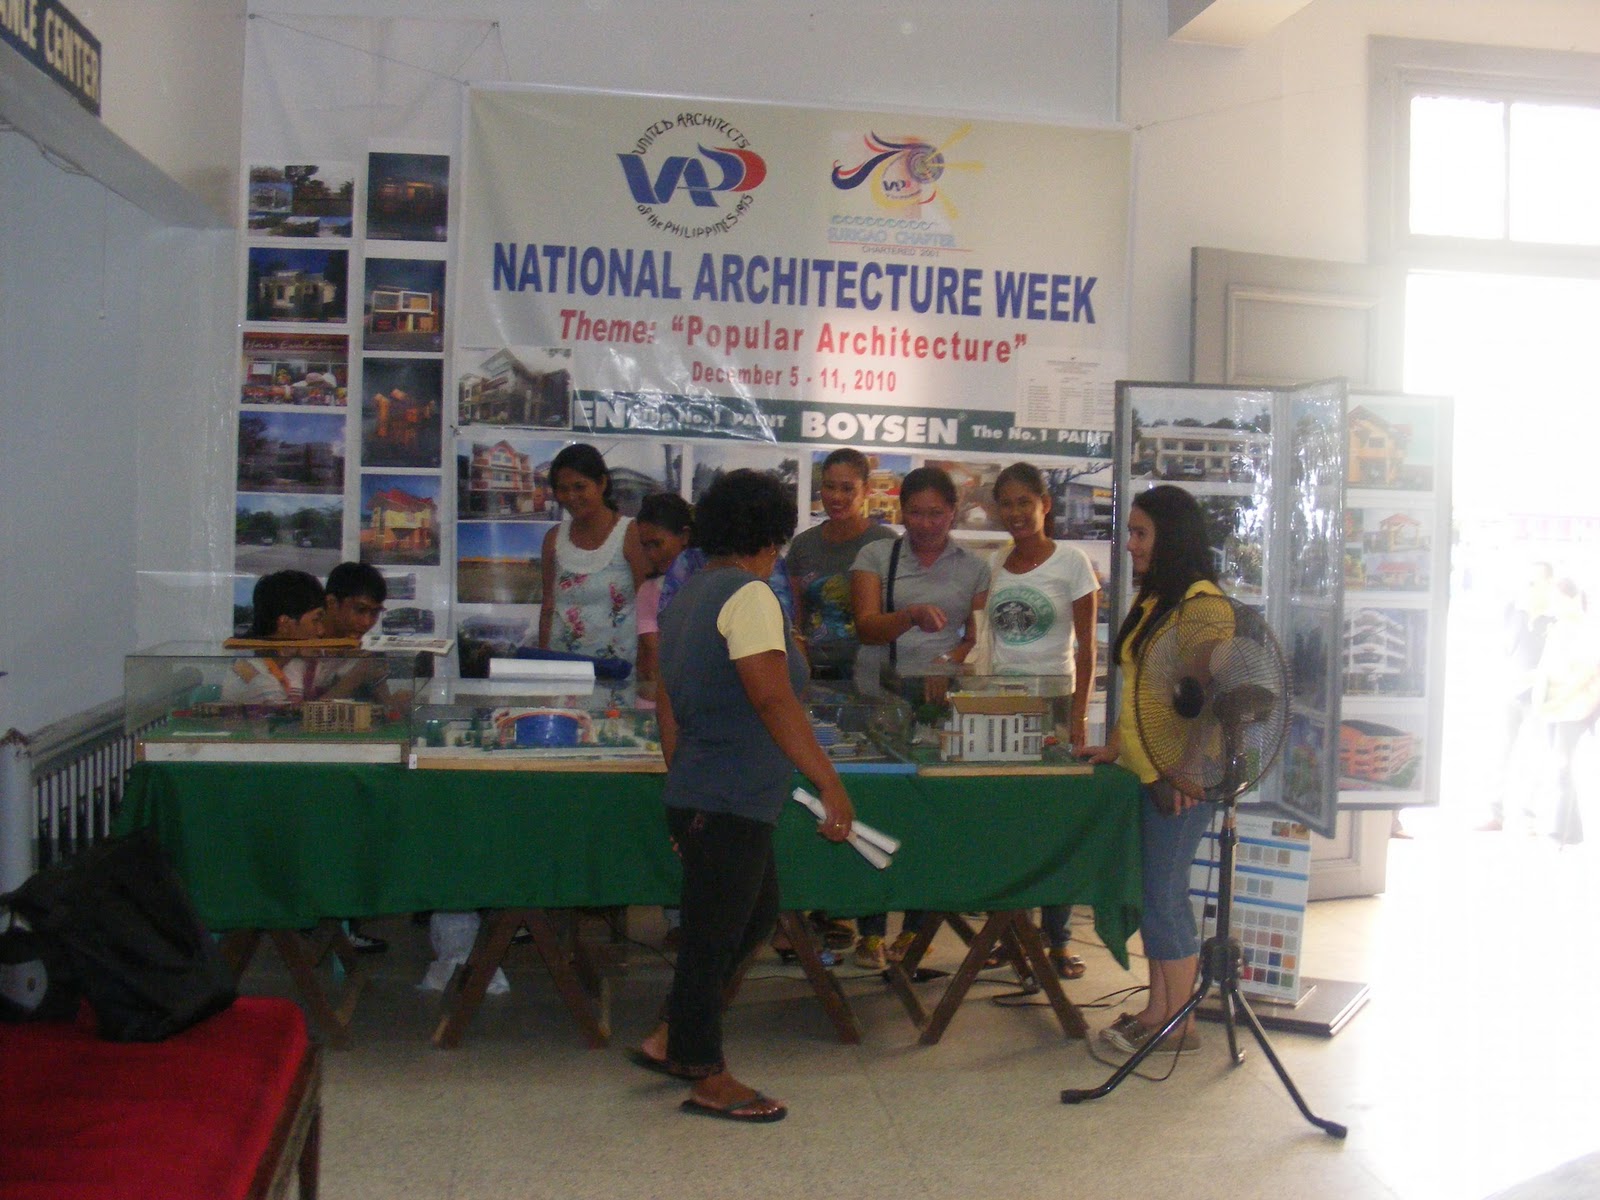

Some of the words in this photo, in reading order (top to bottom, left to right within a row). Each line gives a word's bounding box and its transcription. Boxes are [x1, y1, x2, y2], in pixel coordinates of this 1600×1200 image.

[44, 8, 98, 99] CENTER
[631, 120, 674, 154] UNITED
[677, 113, 750, 149] ARCHITECTS
[637, 204, 652, 215] of
[648, 214, 663, 229] the
[861, 245, 916, 256] CHARTERED
[493, 242, 682, 299] NATIONAL
[692, 252, 983, 316] ARCHITECTURE
[995, 270, 1097, 324] WEEK
[560, 309, 657, 344] Theme:
[672, 314, 804, 356] “Popular
[816, 322, 1027, 364] Architecture”
[692, 361, 781, 386] December
[789, 366, 800, 387] 5
[820, 368, 845, 393] 11,
[854, 370, 896, 392] 2010
[802, 411, 958, 445] BOYSEN
[971, 425, 1003, 440] The
[1009, 427, 1036, 441] No.
[1040, 429, 1048, 442] 1
[1057, 430, 1111, 445] PAINT
